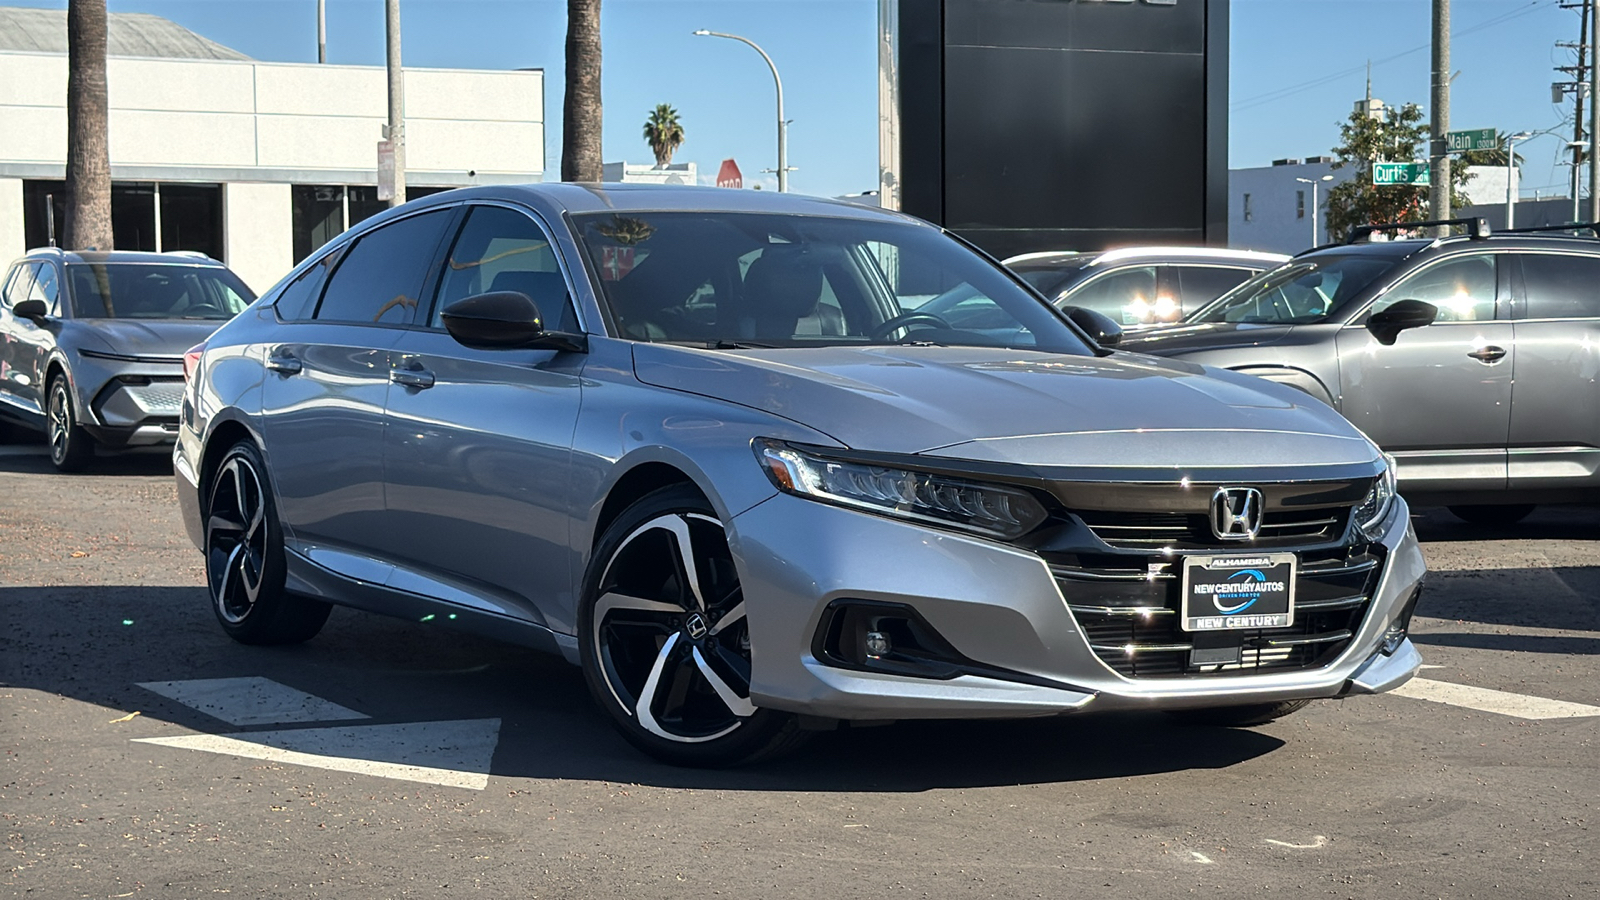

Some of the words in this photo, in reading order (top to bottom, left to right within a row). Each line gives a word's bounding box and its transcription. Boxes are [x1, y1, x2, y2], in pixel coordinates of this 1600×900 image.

[1448, 133, 1471, 149] Main
[1375, 165, 1409, 181] Curtis
[1211, 558, 1270, 567] ALHAMBRA
[1194, 584, 1216, 594] NEW
[1215, 581, 1256, 593] CENTURY
[1254, 581, 1285, 592] AUTOS
[1196, 618, 1223, 629] NEW
[1225, 616, 1280, 628] CENTURY
